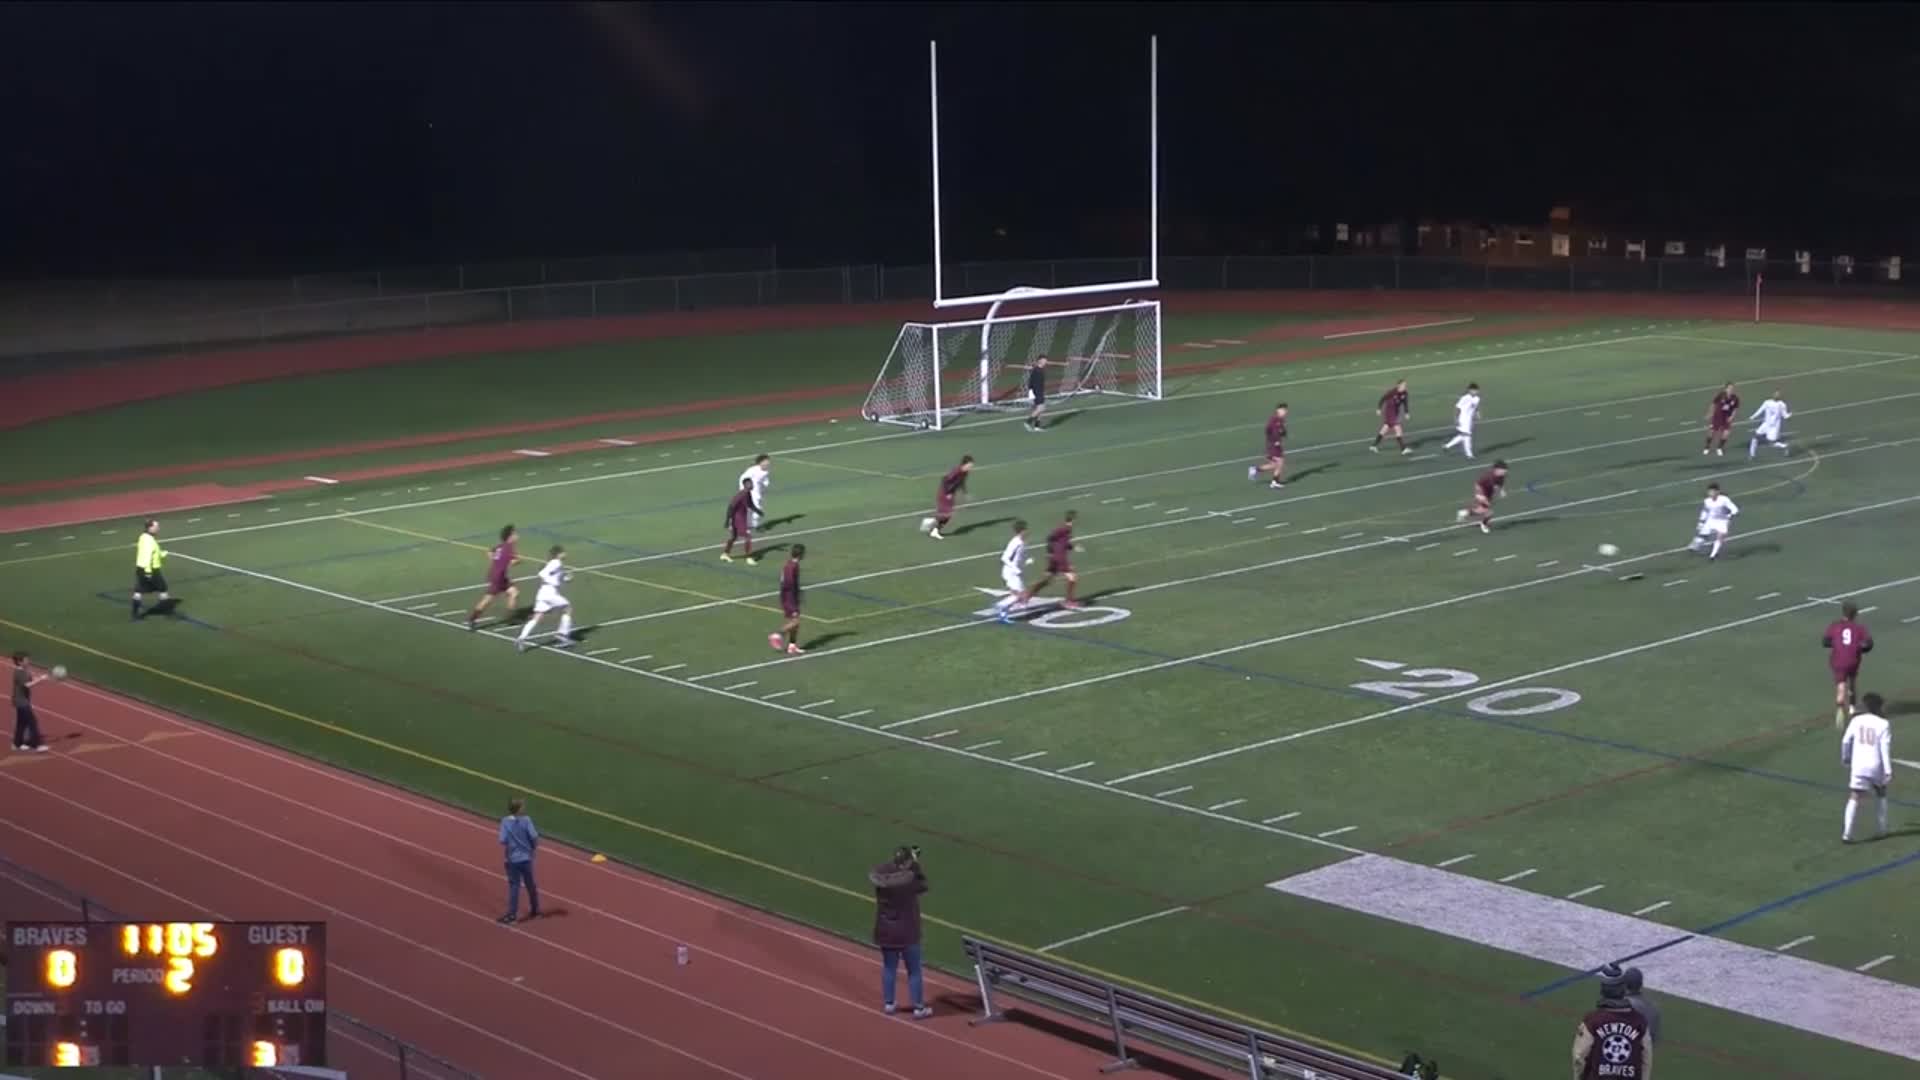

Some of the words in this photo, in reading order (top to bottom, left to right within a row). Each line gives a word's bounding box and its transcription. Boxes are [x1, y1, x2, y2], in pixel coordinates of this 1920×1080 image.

[1842, 628, 1851, 644] 9
[1350, 668, 1581, 715] 20
[1859, 725, 1876, 746] 10
[1596, 1022, 1640, 1041] NEWTON
[1598, 1063, 1635, 1077] BRAVES
